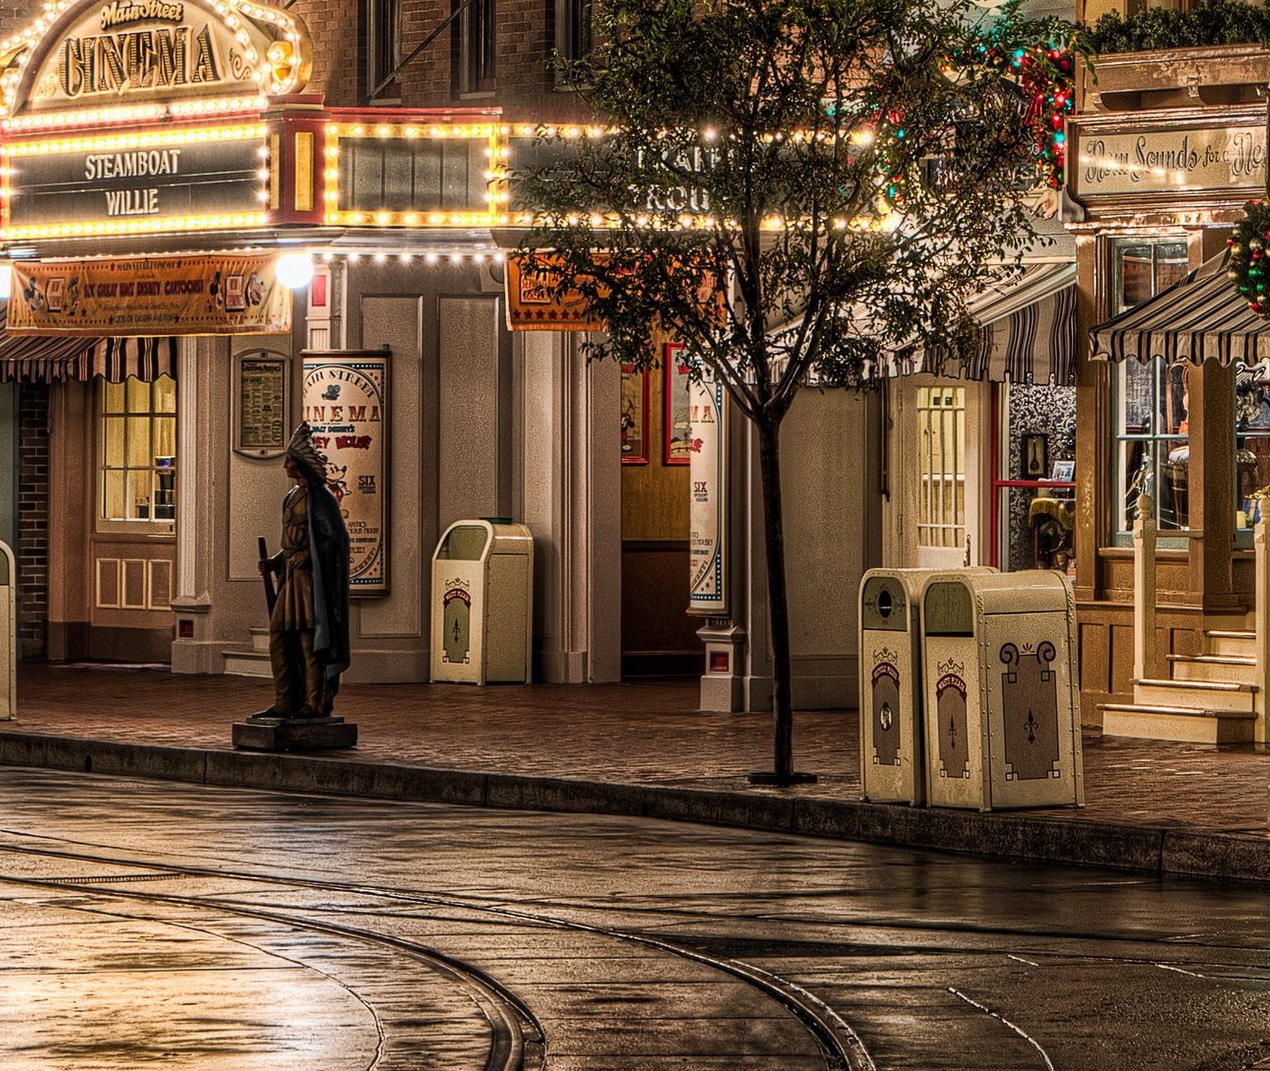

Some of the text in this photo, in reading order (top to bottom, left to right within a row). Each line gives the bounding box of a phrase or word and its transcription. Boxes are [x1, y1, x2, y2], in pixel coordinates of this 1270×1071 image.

[100, 0, 139, 31] Main
[59, 23, 227, 99] CINEMA
[84, 149, 181, 180] STEAMBOAT
[1131, 135, 1201, 182] Sounds
[1203, 145, 1221, 168] for
[1231, 131, 1267, 176] Ne
[105, 188, 160, 216] WILLIE
[329, 369, 375, 399] STREET
[358, 475, 376, 486] SIX
[693, 481, 708, 493] SIX
